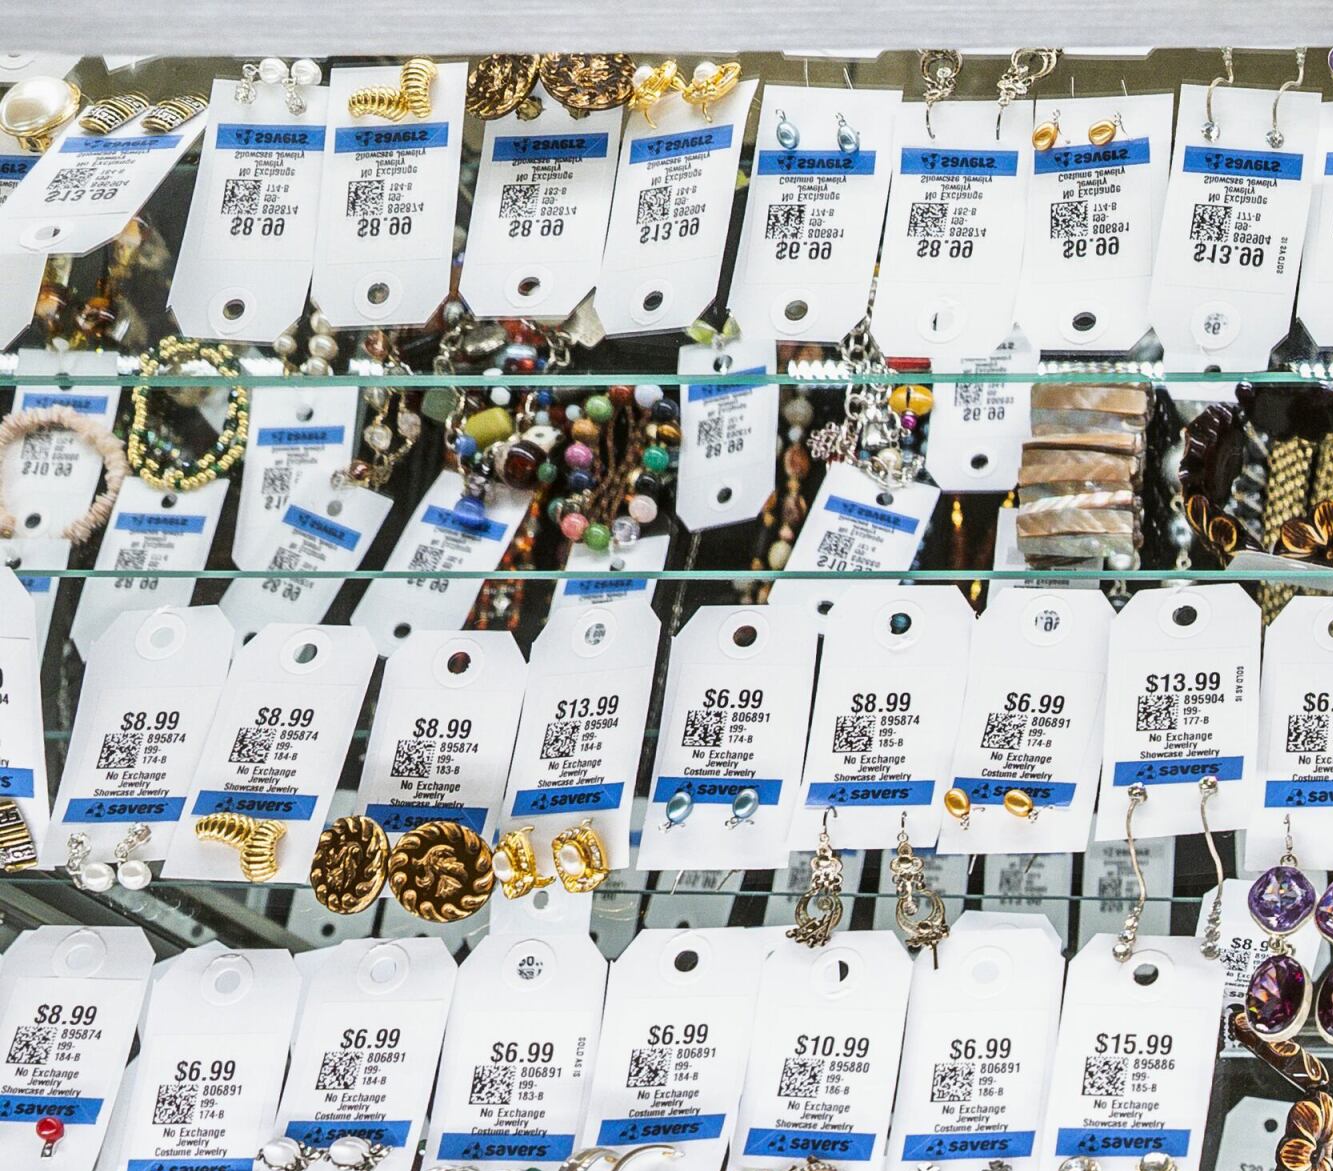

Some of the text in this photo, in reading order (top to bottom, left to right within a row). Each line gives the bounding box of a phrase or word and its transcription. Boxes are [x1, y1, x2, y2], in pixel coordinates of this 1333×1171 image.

[1145, 671, 1220, 694] $13.99
[555, 694, 619, 721] $13.99
[702, 688, 763, 709] $6.99
[850, 692, 910, 714] $8.99
[1003, 691, 1064, 714] $6.99
[1183, 693, 1224, 704] 895904
[120, 710, 179, 732] $8.99
[254, 706, 314, 727] $8.99
[583, 717, 618, 730] 895904
[880, 714, 919, 726] 895874
[146, 732, 186, 743] 895874
[412, 717, 471, 739] $8.99
[1148, 731, 1212, 742] No Exchange
[1139, 748, 1220, 759] Showcase Jewelry
[1163, 740, 1197, 749] Jewelry
[1158, 762, 1222, 776] savers
[106, 802, 167, 815] savers
[548, 790, 603, 806] savers
[33, 1003, 97, 1025] $8.99
[339, 1028, 400, 1050] $6.99
[647, 1023, 708, 1047] $6.99
[1094, 1032, 1172, 1055] $15.99
[490, 1041, 553, 1064] $6.99
[794, 1034, 869, 1058] $10.99
[949, 1037, 1011, 1060] $6.99
[174, 1059, 235, 1082] $6.99
[520, 1066, 561, 1078] 806891
[1133, 1058, 1174, 1070] 895886
[202, 1084, 242, 1096] 806891
[13, 1102, 79, 1116] savers
[947, 1138, 1011, 1152] savers
